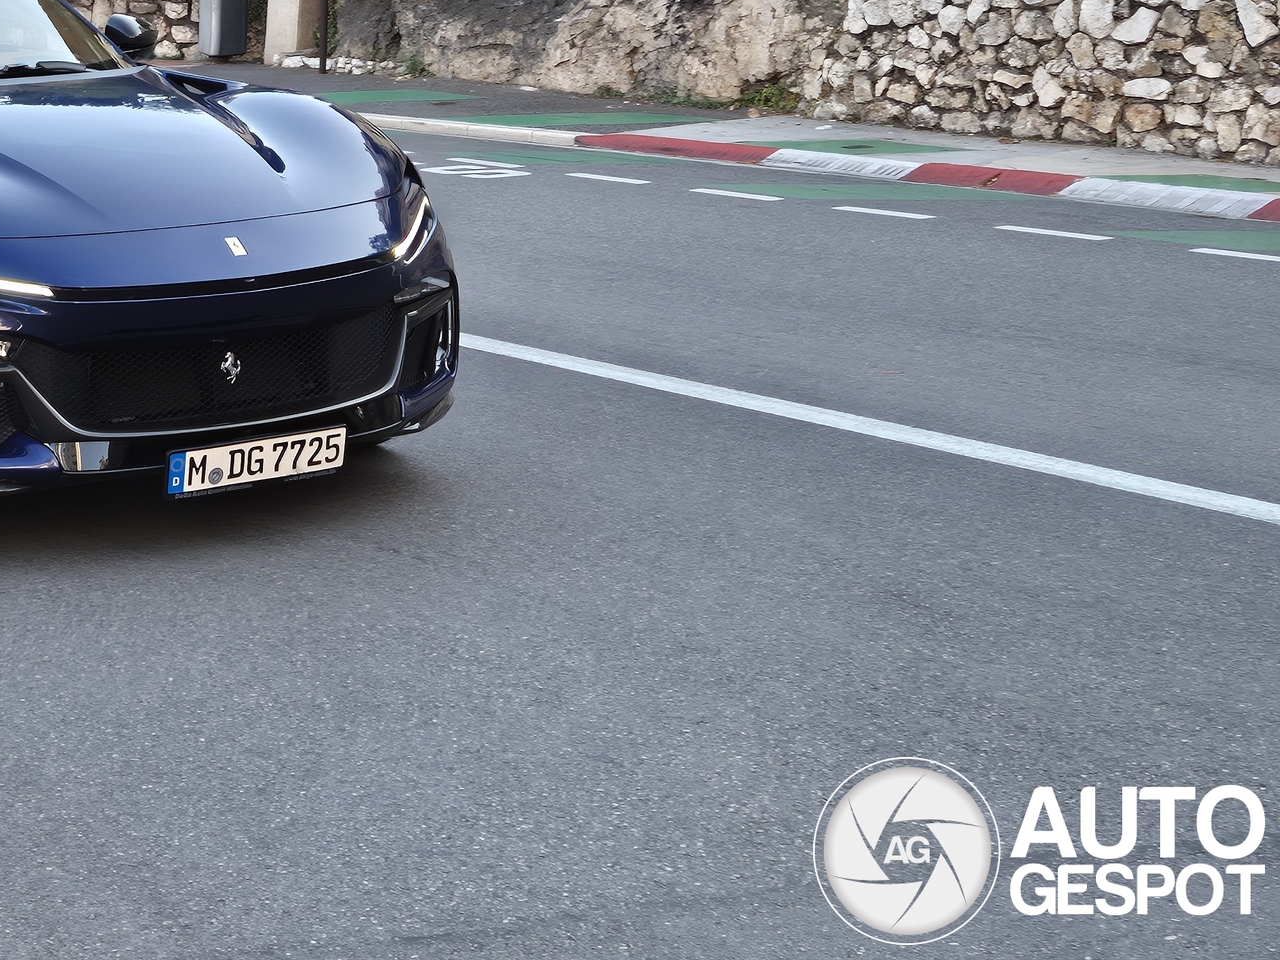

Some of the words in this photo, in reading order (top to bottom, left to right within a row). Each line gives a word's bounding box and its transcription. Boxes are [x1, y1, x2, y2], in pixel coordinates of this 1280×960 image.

[172, 477, 180, 487] D
[187, 454, 208, 487] M
[227, 445, 264, 480] DG
[272, 433, 342, 473] 7725
